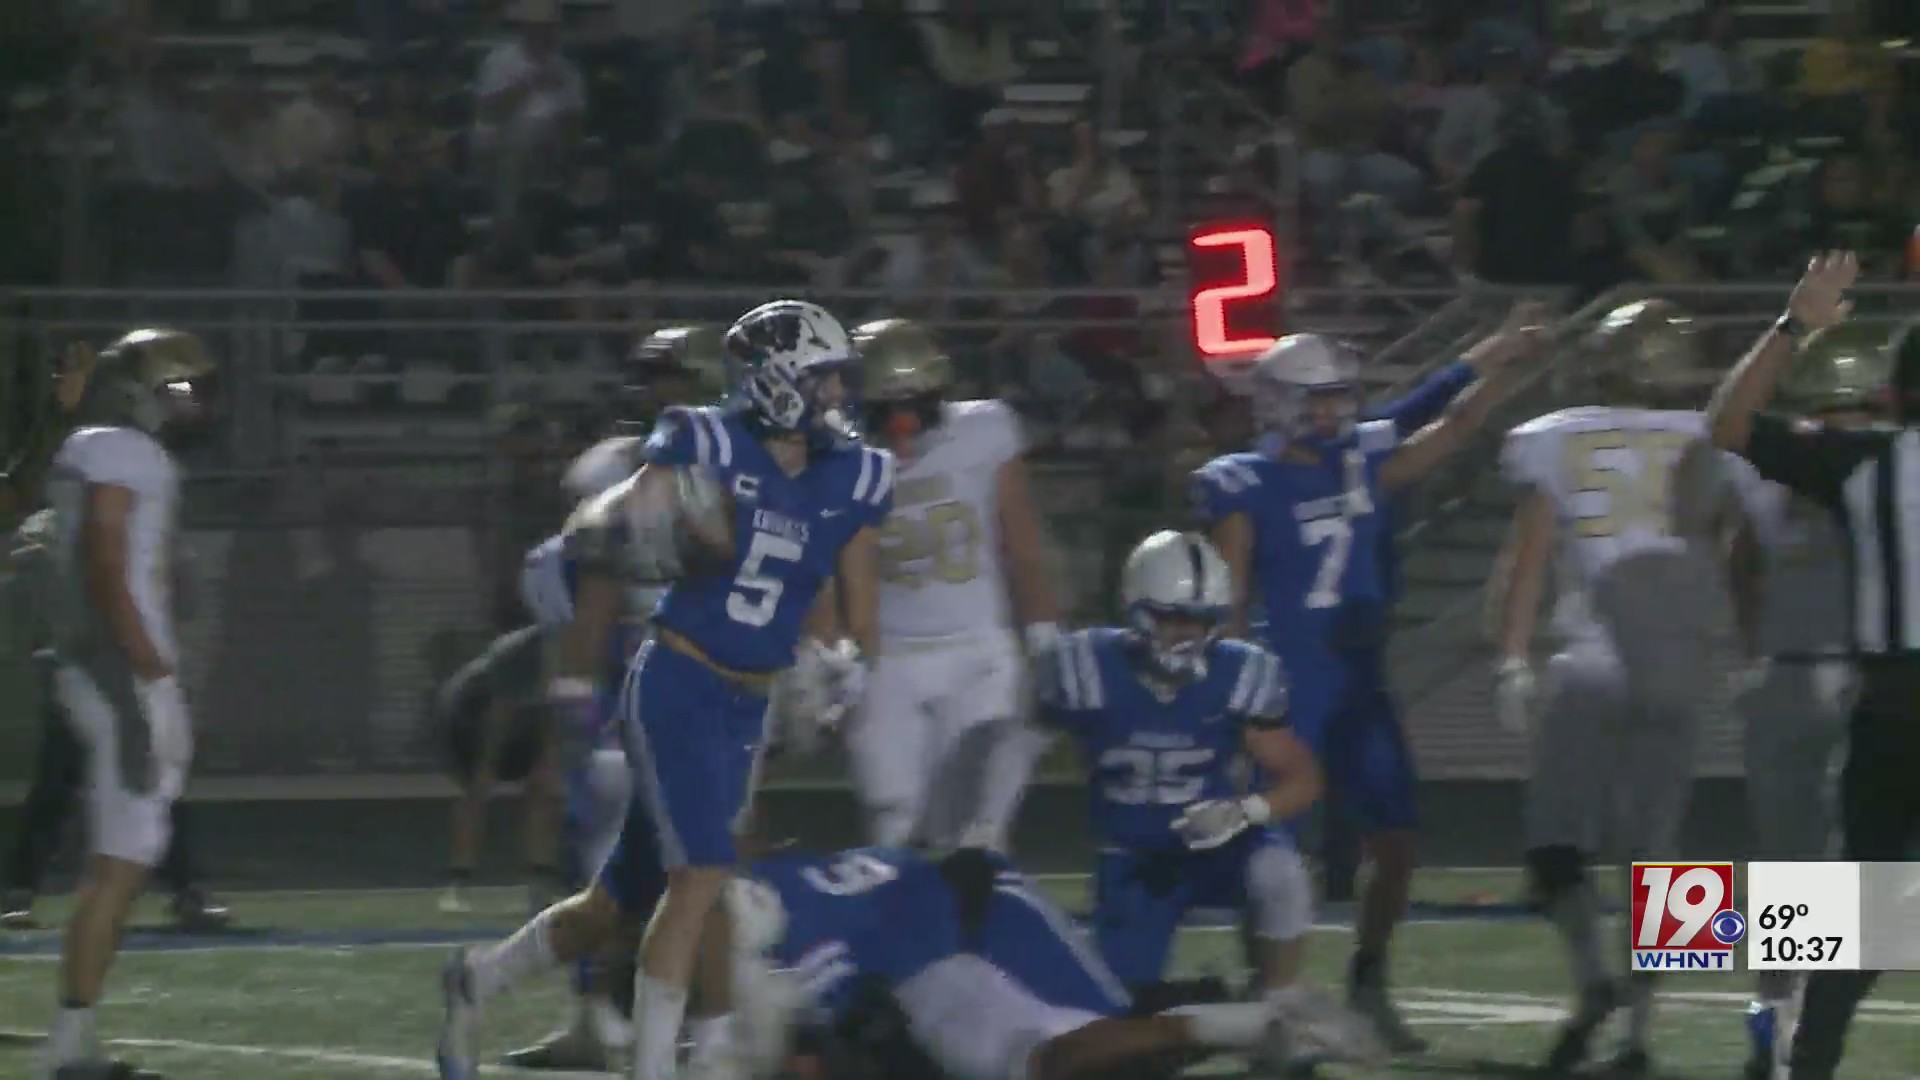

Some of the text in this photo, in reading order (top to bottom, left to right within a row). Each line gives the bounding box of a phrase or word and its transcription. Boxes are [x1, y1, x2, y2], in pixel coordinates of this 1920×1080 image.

[1193, 228, 1276, 355] 2
[725, 531, 804, 627] 5
[1299, 518, 1354, 609] 7
[1100, 749, 1216, 805] 35
